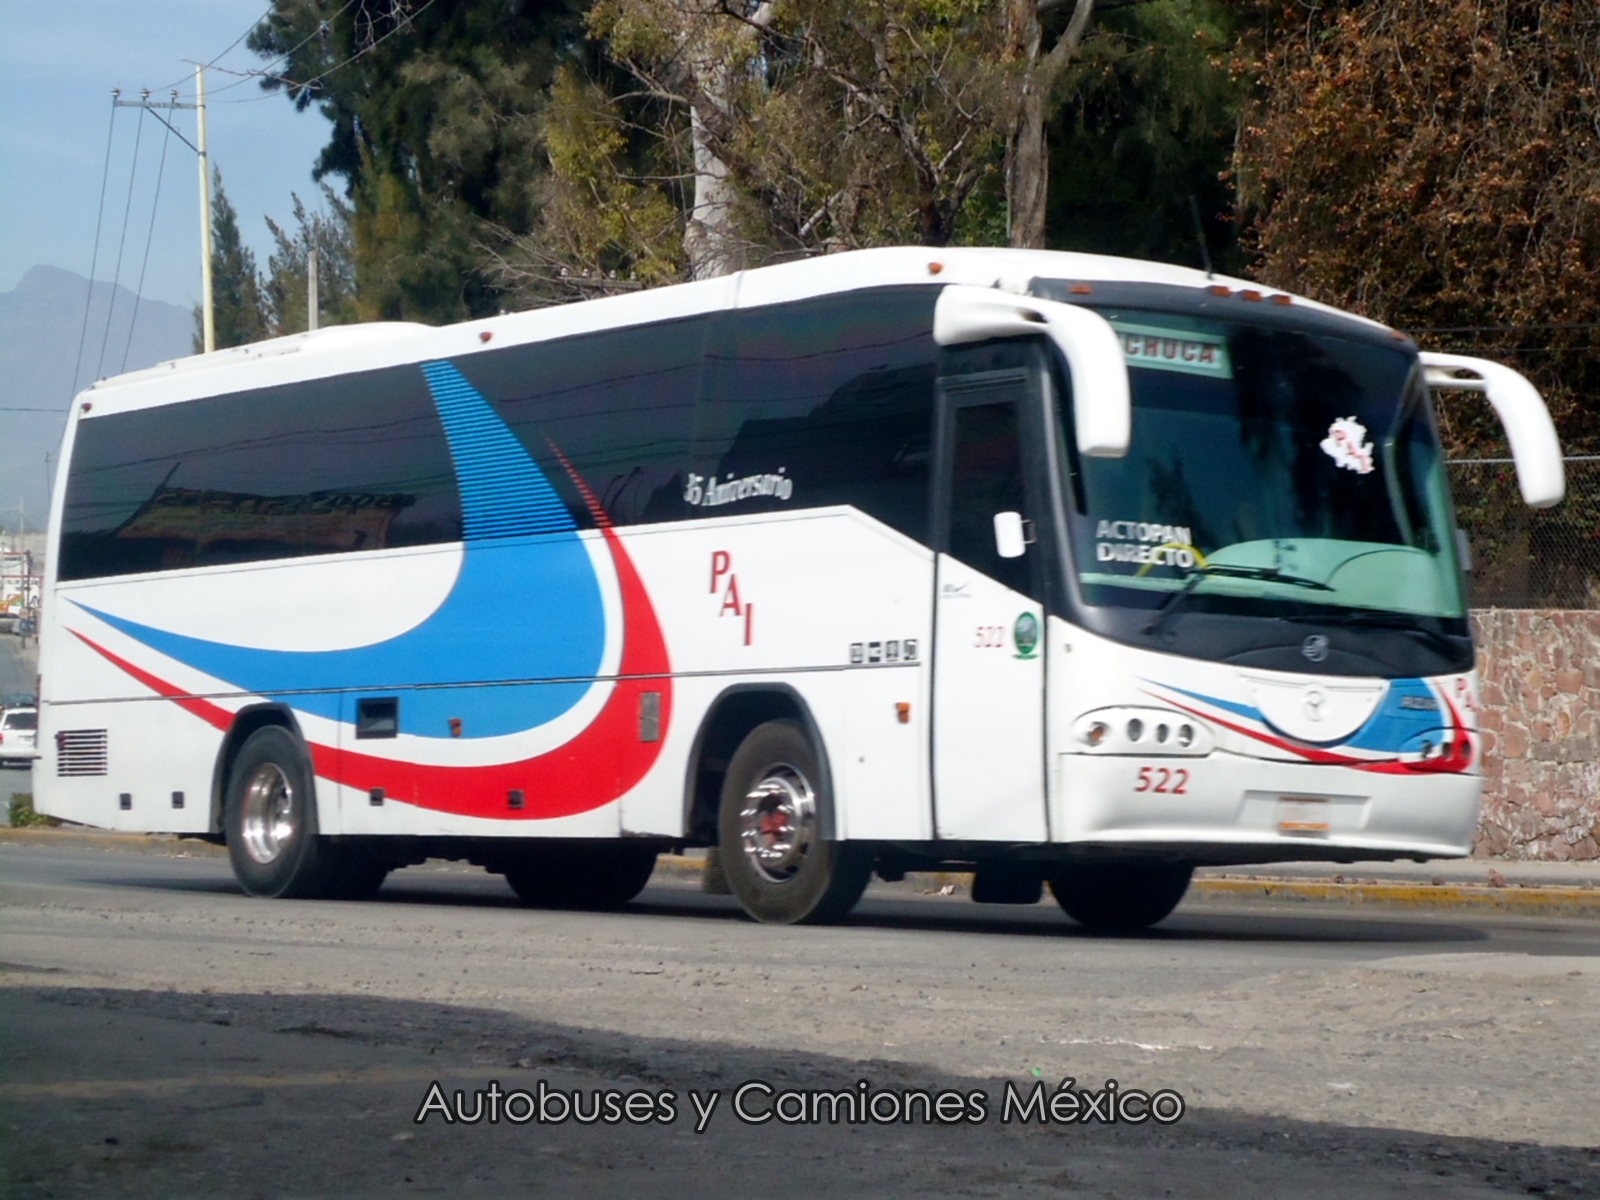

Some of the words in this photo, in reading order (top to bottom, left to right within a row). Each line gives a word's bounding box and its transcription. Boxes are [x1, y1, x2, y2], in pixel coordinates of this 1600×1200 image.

[1119, 333, 1217, 364] CHUCA
[1096, 519, 1192, 546] ACTOPAN
[1096, 542, 1195, 568] DIRECTO
[709, 550, 752, 646] PAI
[1134, 766, 1190, 795] 522
